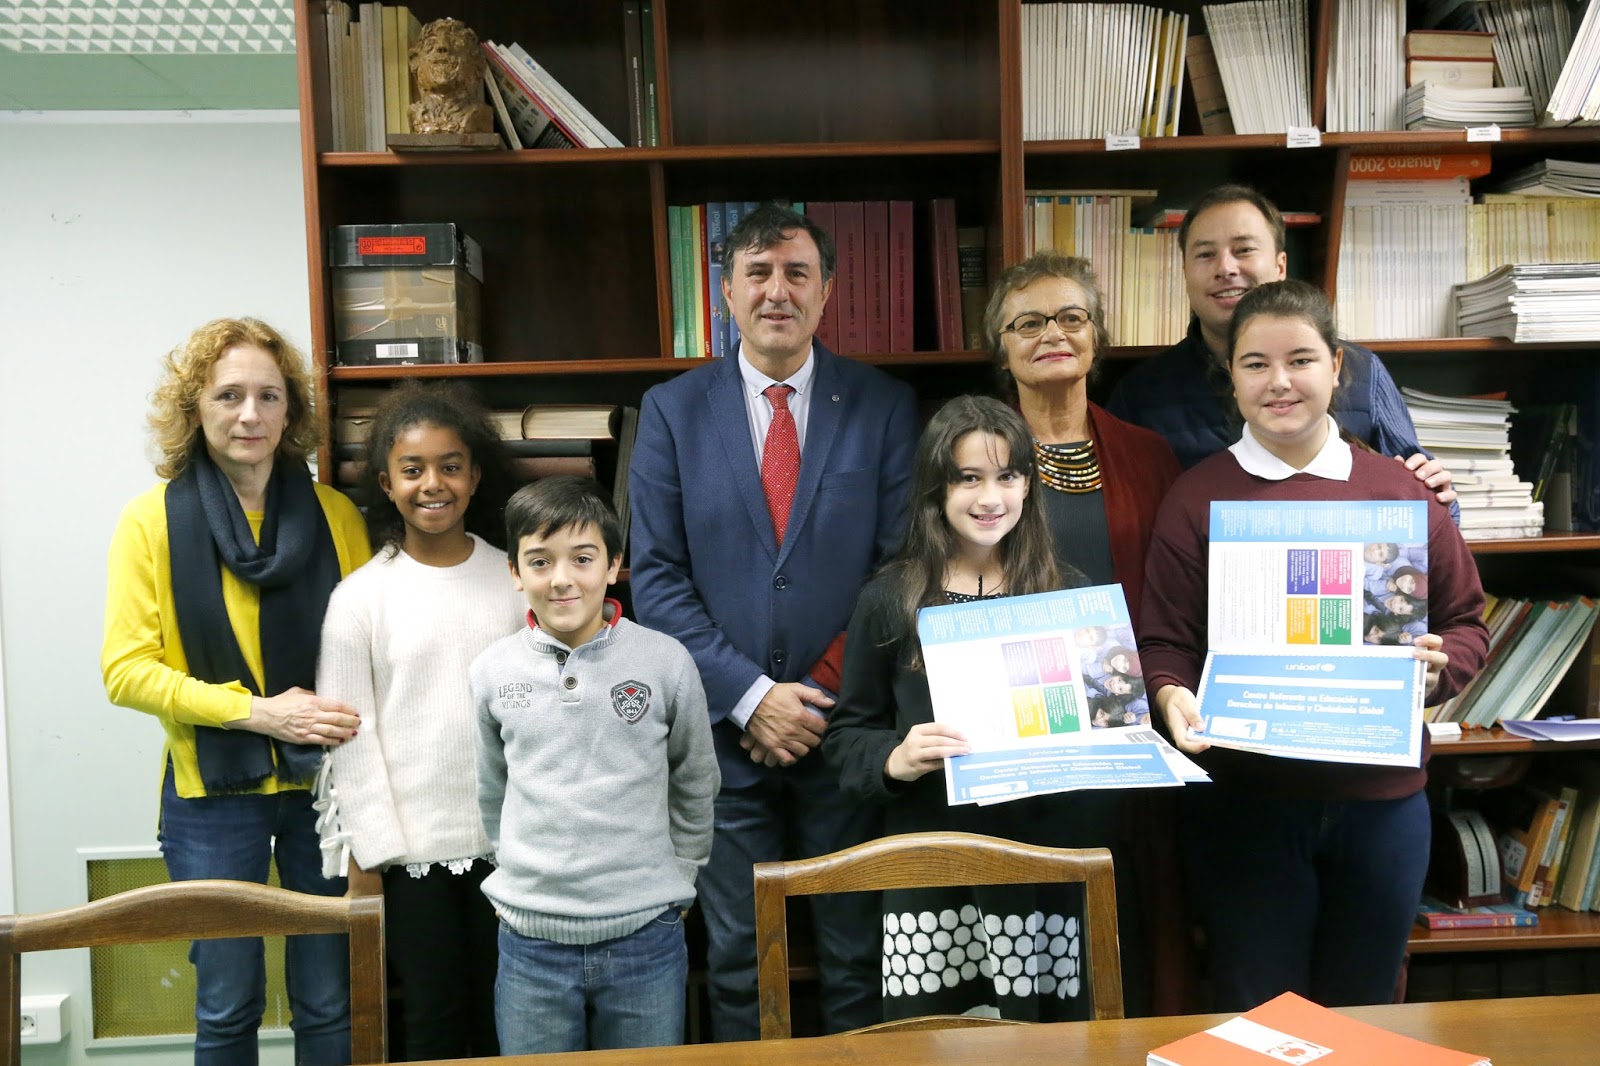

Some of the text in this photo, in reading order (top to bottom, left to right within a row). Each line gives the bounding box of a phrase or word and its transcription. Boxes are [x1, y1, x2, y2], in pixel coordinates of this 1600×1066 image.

[1350, 157, 1441, 172] Anuario 2000
[1286, 663, 1321, 671] unicef
[499, 683, 532, 698] LEGEND
